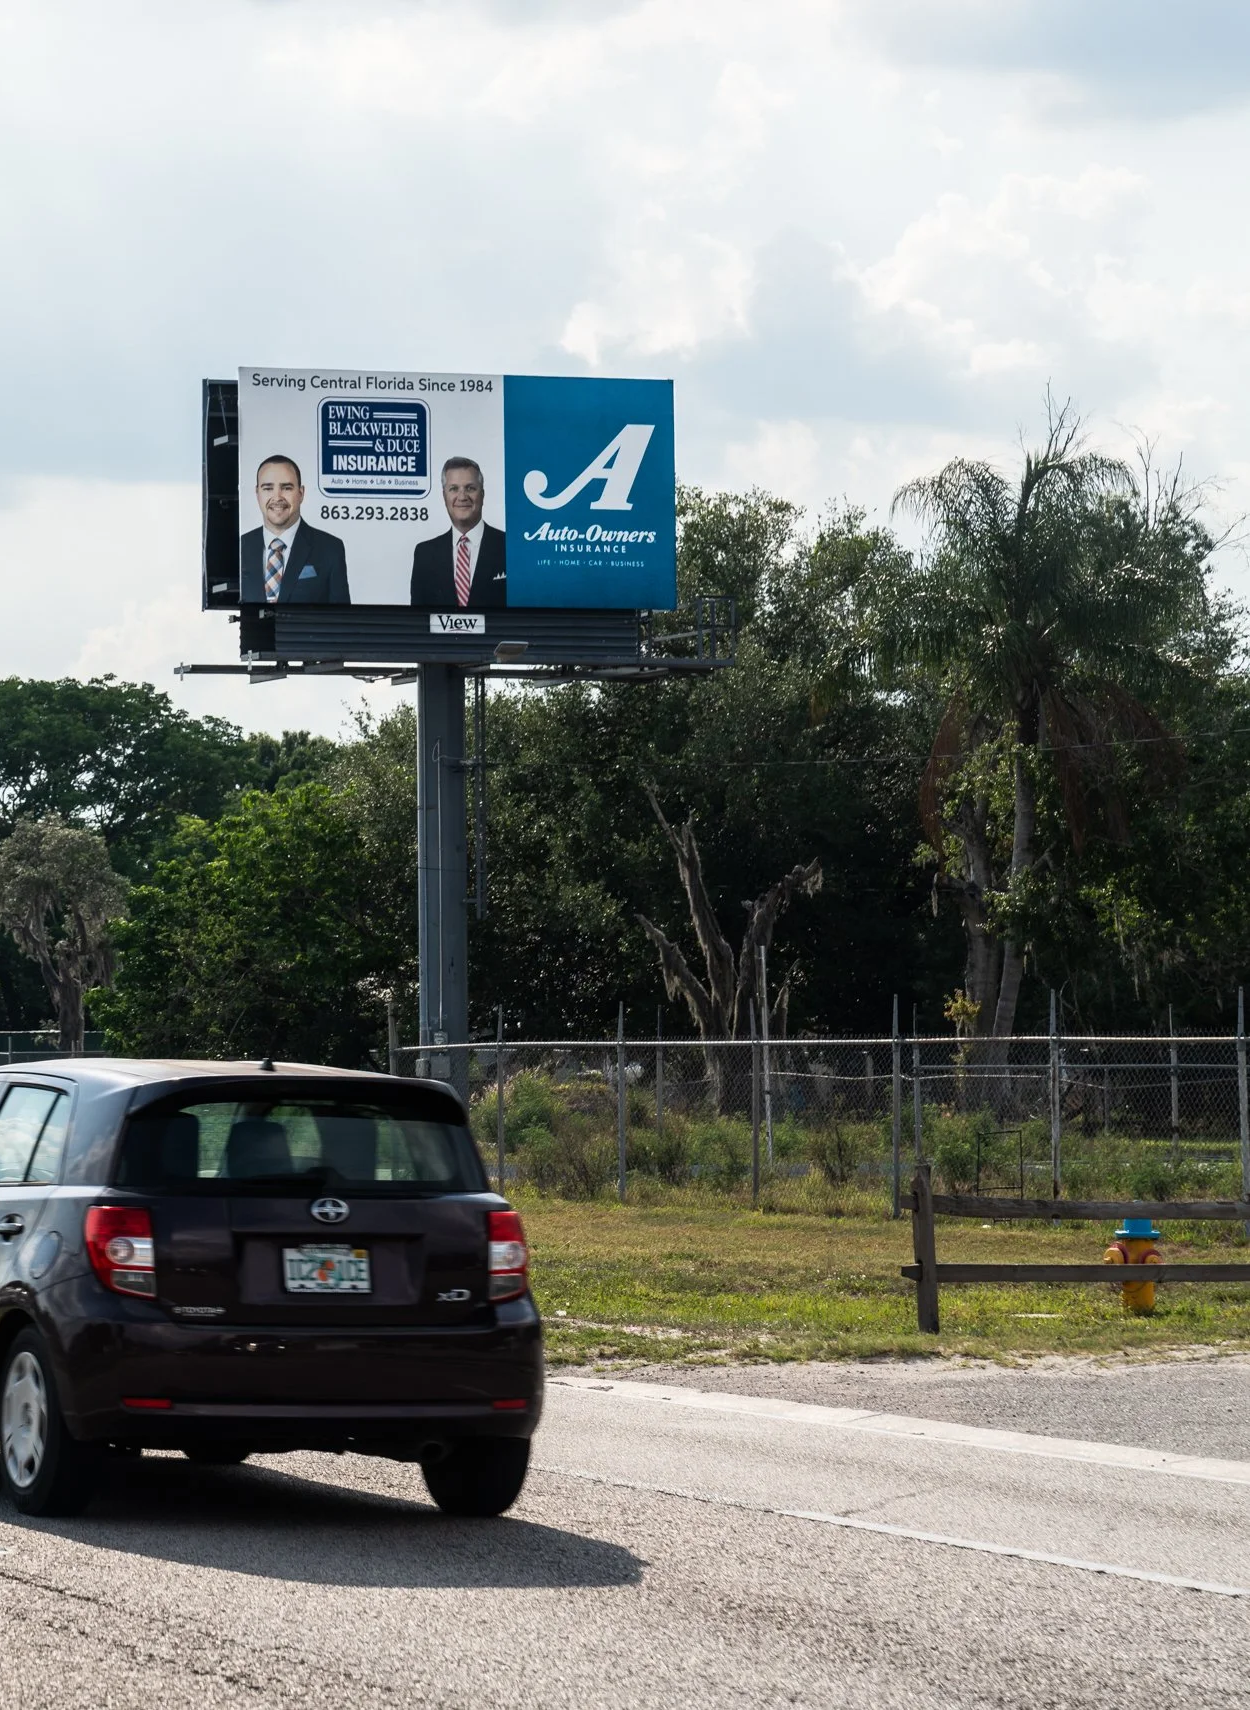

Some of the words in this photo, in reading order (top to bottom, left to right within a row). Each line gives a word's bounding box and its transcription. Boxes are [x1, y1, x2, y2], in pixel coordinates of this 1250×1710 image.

[252, 373, 306, 391] Serving
[310, 375, 361, 389] Central
[366, 376, 414, 391] Florida
[418, 378, 456, 392] Since
[460, 380, 493, 392] 1984
[328, 405, 370, 420] EWING
[328, 421, 419, 437] BLACKWELDER
[374, 438, 385, 453] &
[387, 439, 421, 454] DUCE
[332, 454, 417, 472] INSURANCE
[523, 424, 655, 510] A
[351, 478, 368, 486] Home
[394, 478, 419, 487] Business
[320, 505, 429, 522] 863.293.2838
[523, 522, 657, 544] Auto-Owners
[554, 544, 627, 554] INSURANCE
[588, 559, 603, 567] CAR
[610, 560, 645, 568] BUSINESS
[437, 614, 478, 631] View
